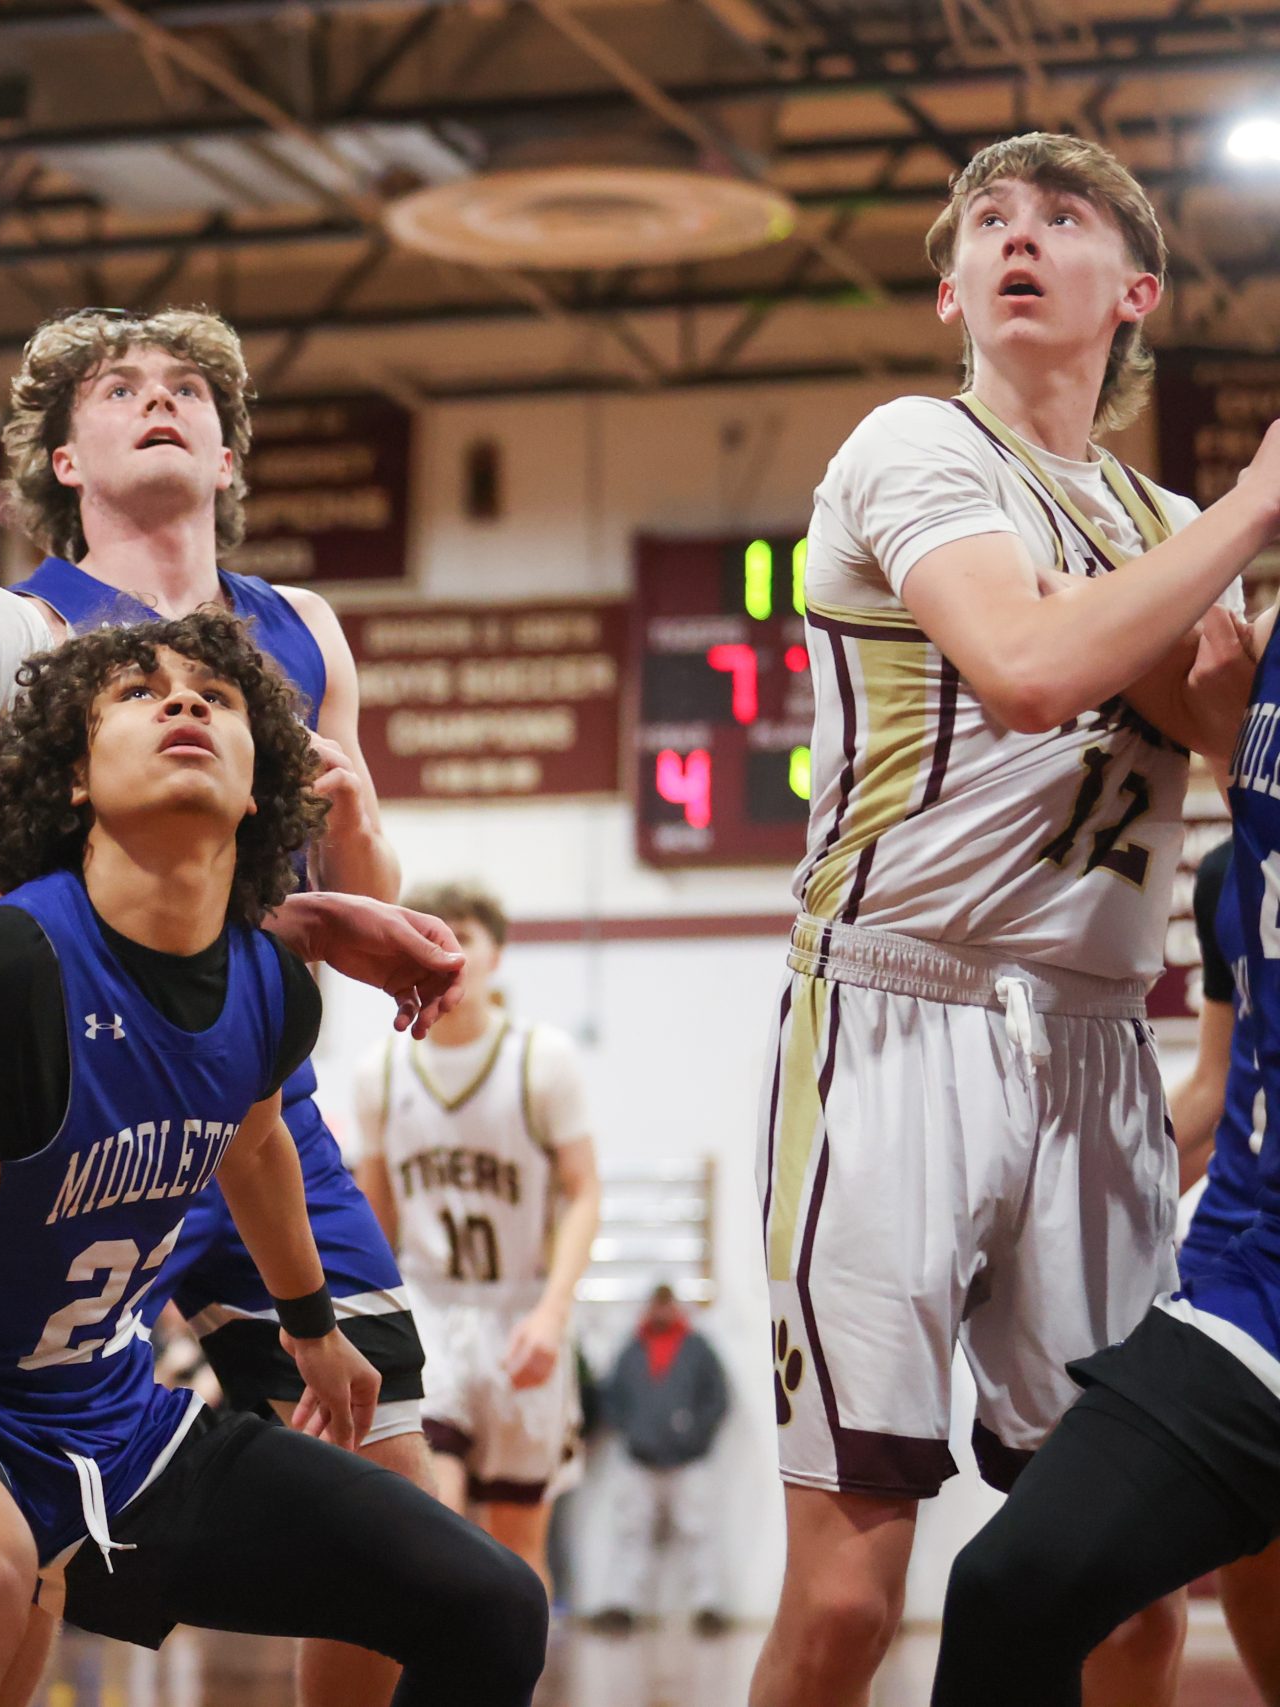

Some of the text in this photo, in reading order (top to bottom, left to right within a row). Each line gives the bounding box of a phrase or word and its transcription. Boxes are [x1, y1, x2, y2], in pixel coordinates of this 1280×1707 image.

[706, 643, 758, 726] 7
[656, 749, 712, 829] 4
[1036, 744, 1156, 892] 12
[45, 1118, 240, 1226] MIDDLETO
[400, 1147, 520, 1207] TIGERS
[439, 1204, 498, 1283] 10
